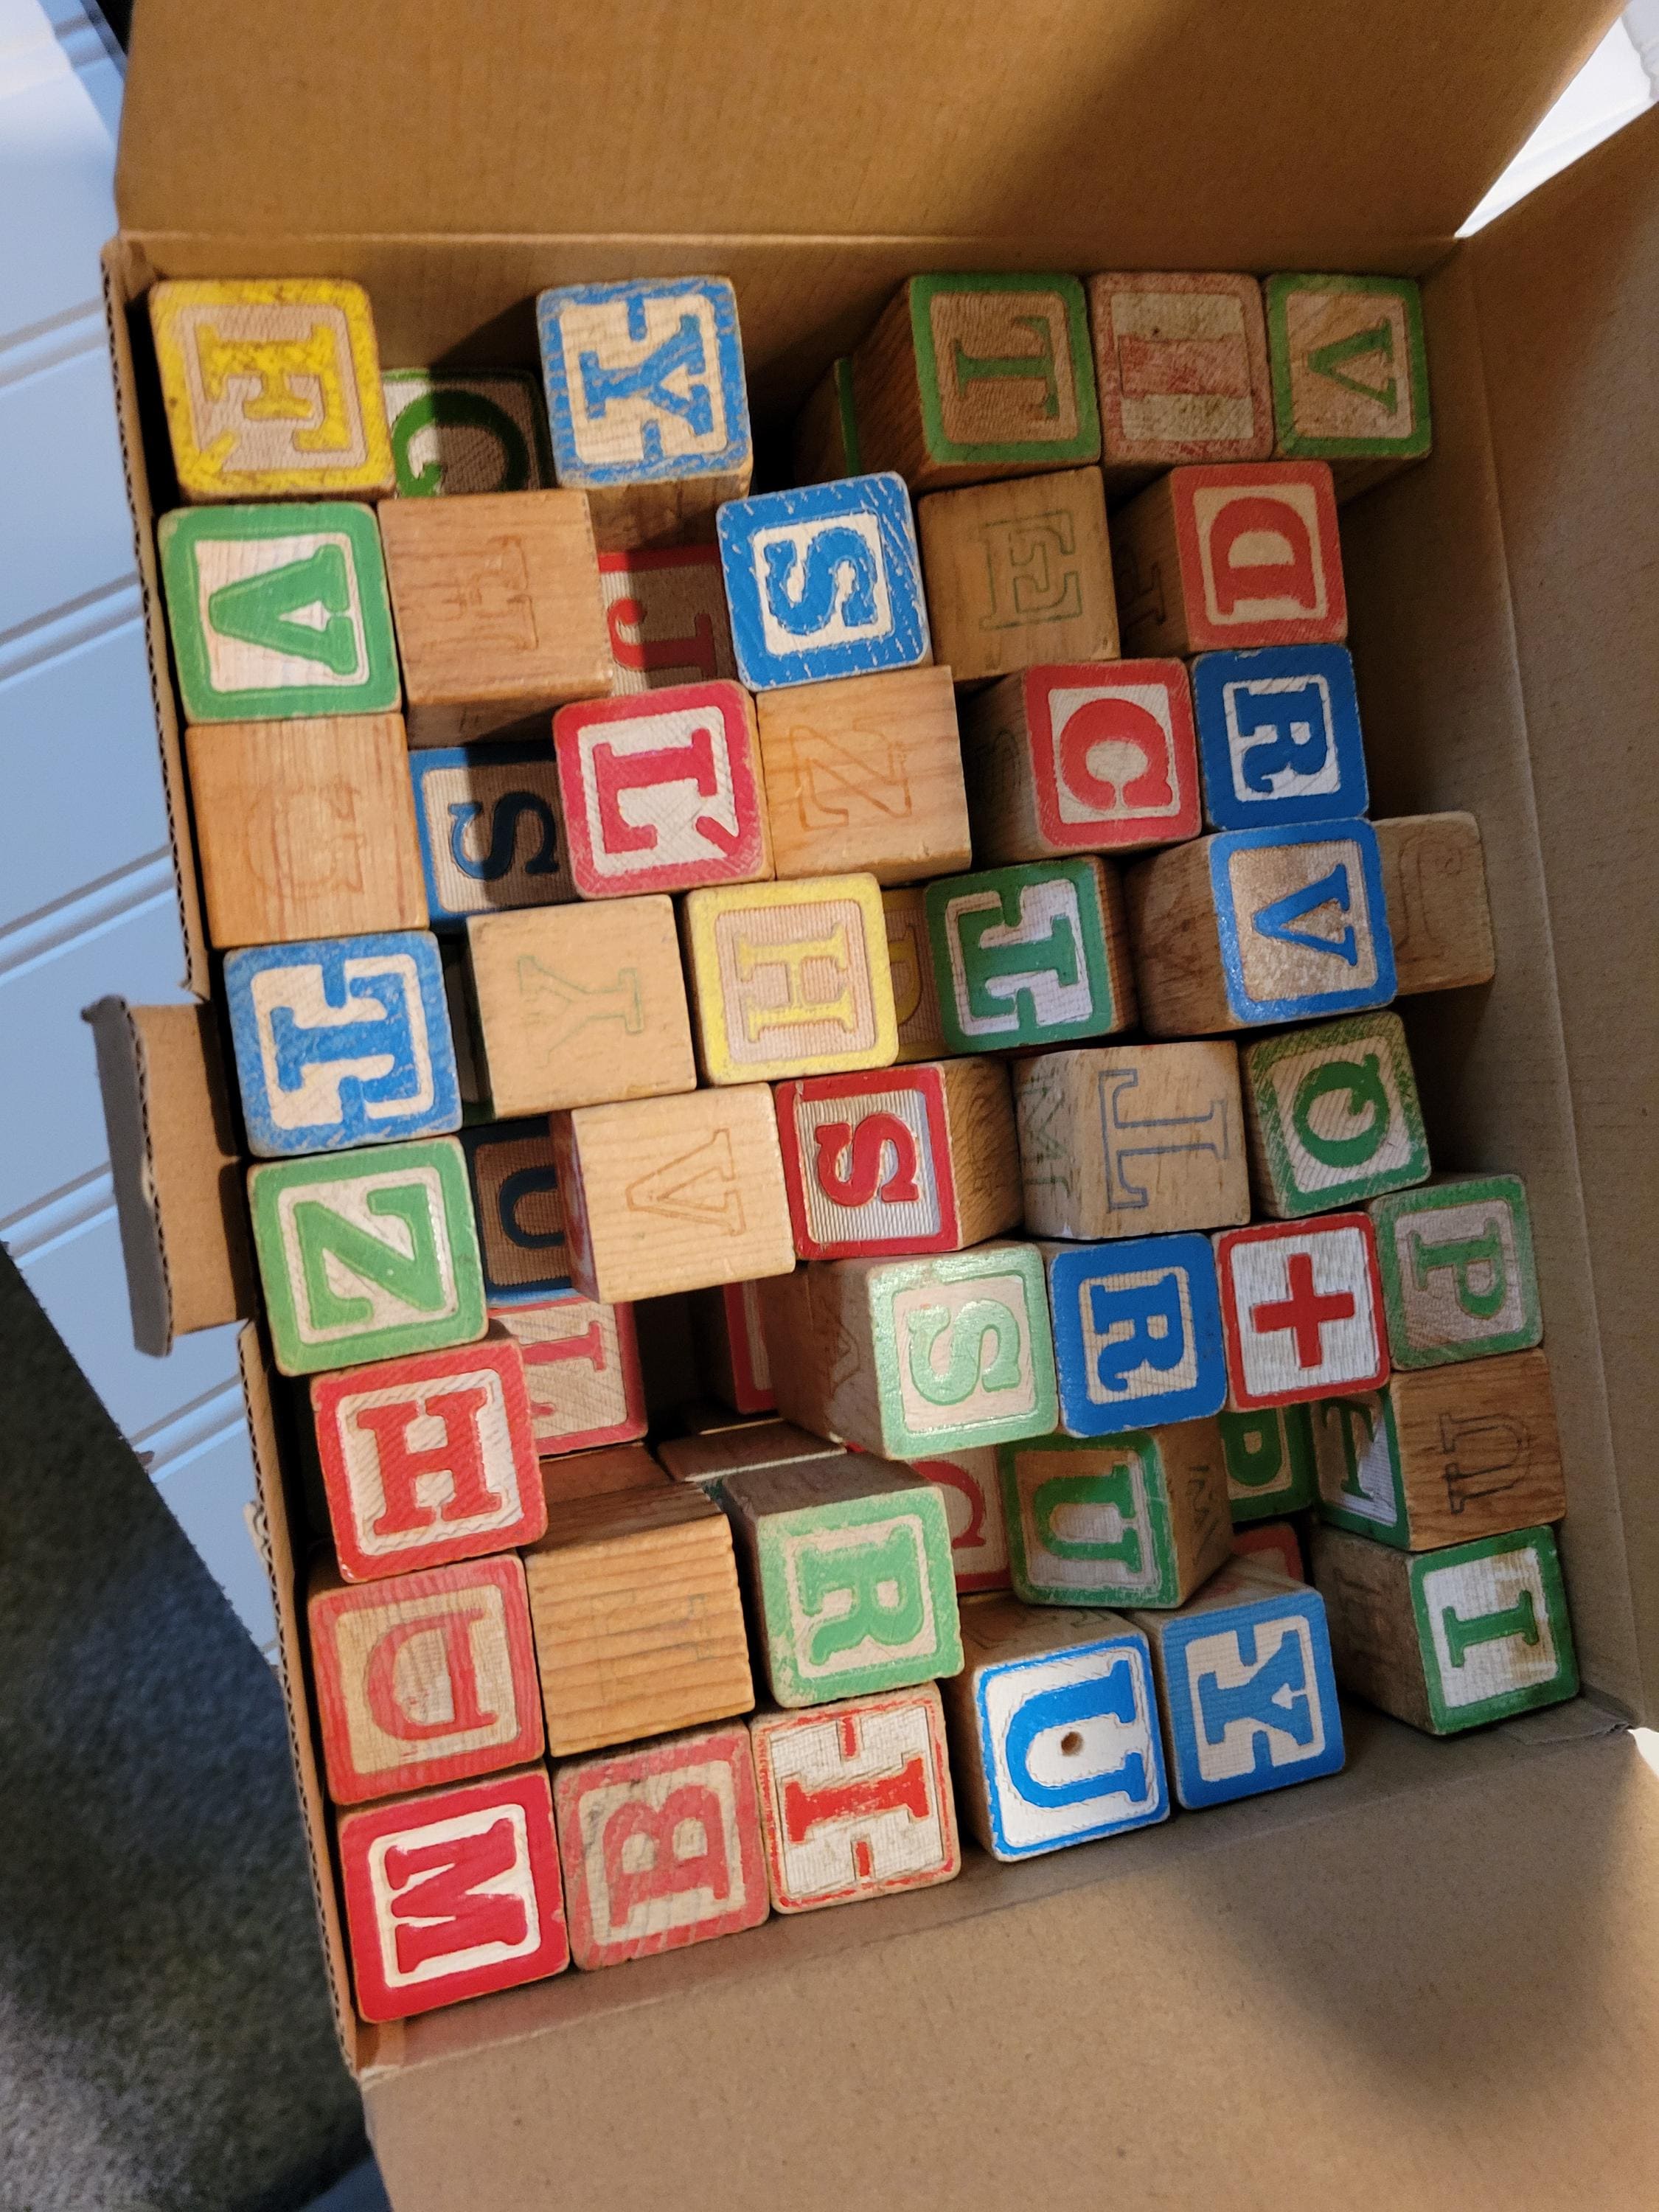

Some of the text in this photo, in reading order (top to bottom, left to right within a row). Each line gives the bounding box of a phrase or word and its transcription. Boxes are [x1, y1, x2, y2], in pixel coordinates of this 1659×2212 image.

[195, 322, 350, 452] F
[579, 314, 714, 437] Y
[953, 316, 1059, 421] T
[763, 526, 878, 636] S
[978, 509, 1082, 632] E
[1209, 495, 1318, 616] D
[592, 727, 719, 853] L
[1060, 698, 1173, 810] C
[1232, 683, 1329, 793] R
[448, 791, 560, 881] S
[958, 908, 1079, 1018] T
[1253, 863, 1358, 967] V
[269, 975, 425, 1102] T
[517, 956, 644, 1068] Y
[737, 923, 857, 1044] H
[815, 1111, 920, 1208] S
[1099, 1068, 1229, 1213] T
[1293, 1053, 1390, 1169] Q
[1408, 1216, 1507, 1320] P
[906, 1298, 1022, 1406] S
[1089, 1273, 1186, 1392] R
[356, 1386, 503, 1537] H
[1033, 1463, 1142, 1572] U
[1438, 1411, 1531, 1515] U
[798, 1525, 924, 1666] R
[1442, 1589, 1540, 1669] I
[366, 1608, 498, 1742] D
[1197, 1630, 1315, 1746] Y
[1005, 1659, 1147, 1808] U
[603, 1784, 729, 1928] B
